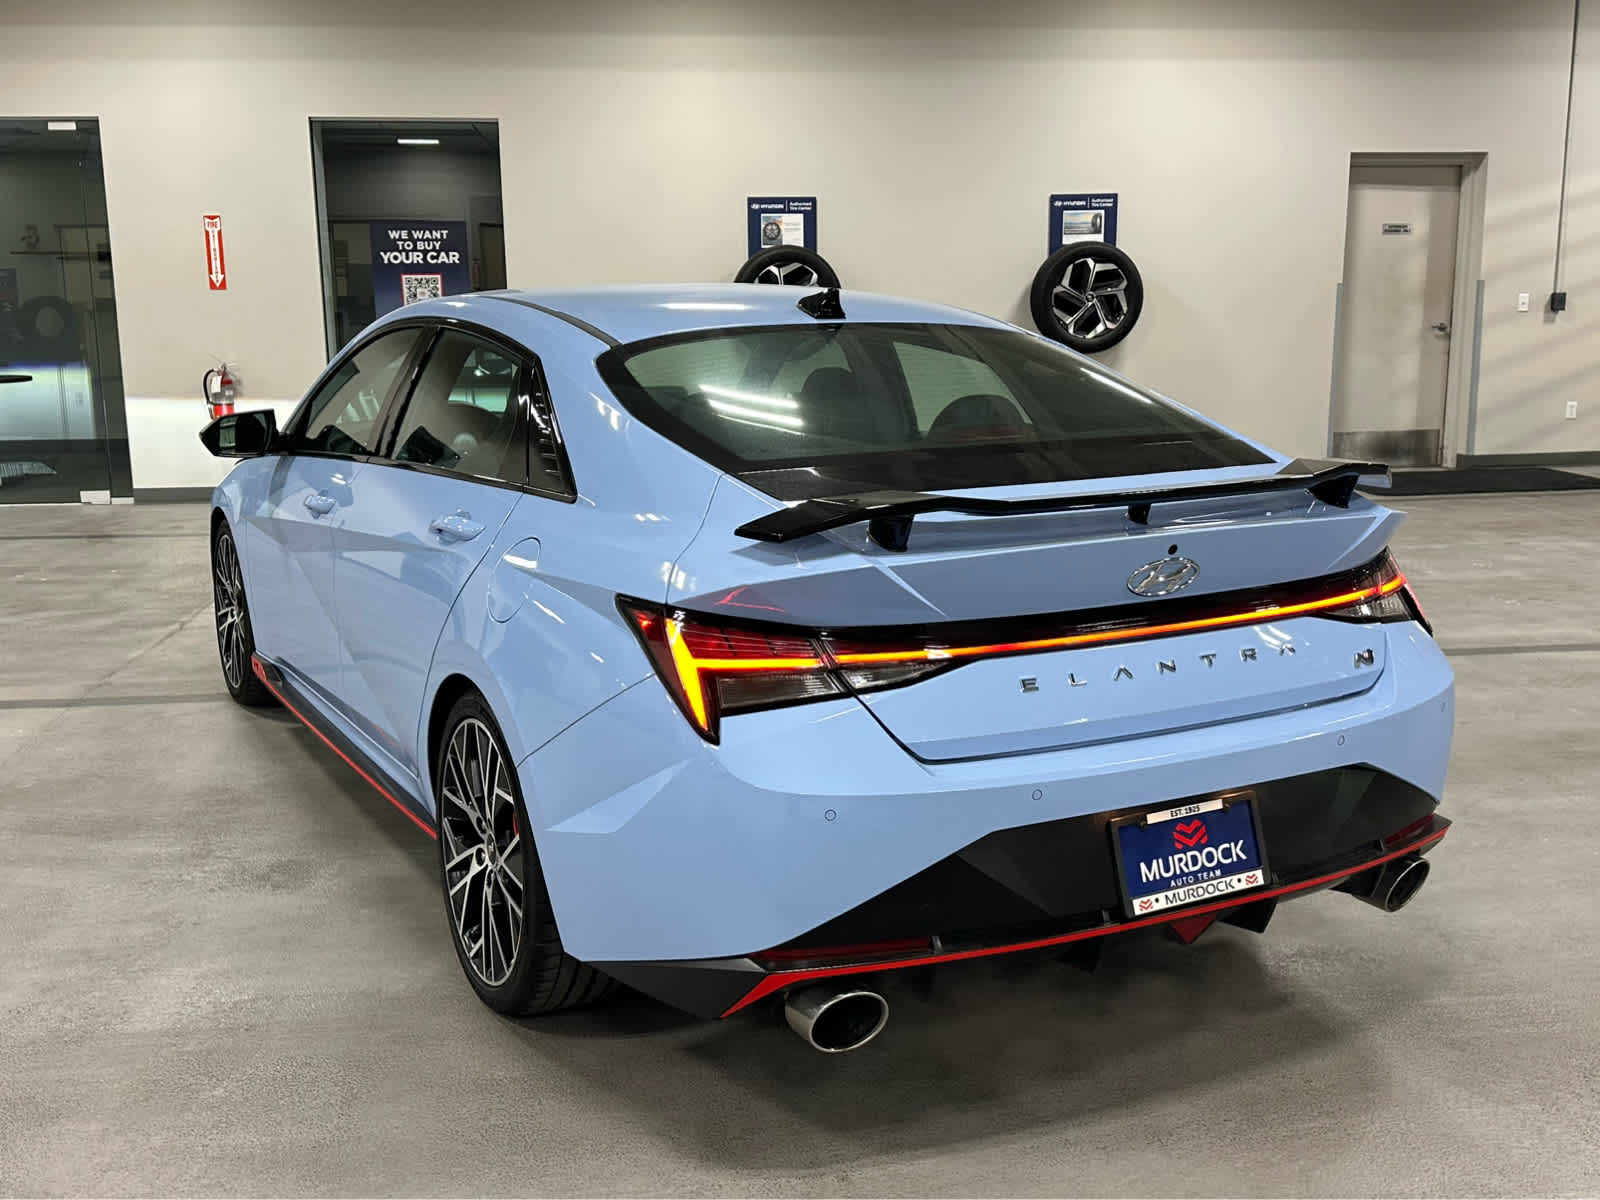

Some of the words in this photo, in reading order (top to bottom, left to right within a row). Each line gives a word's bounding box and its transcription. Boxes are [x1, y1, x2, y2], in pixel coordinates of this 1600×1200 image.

[207, 221, 218, 229] FIRE
[388, 230, 409, 239] WE
[411, 230, 449, 239] WANT
[396, 241, 413, 250] TO
[417, 241, 441, 250] BUY
[380, 251, 424, 264] YOUR
[426, 251, 460, 264] CAR
[1019, 643, 1296, 693] ELANTRA
[1185, 804, 1200, 815] 1925
[1139, 839, 1247, 883] MURDOCK
[1170, 876, 1194, 888] AUTO
[1198, 869, 1222, 883] TEAM
[1164, 878, 1235, 905] MURDOCK
